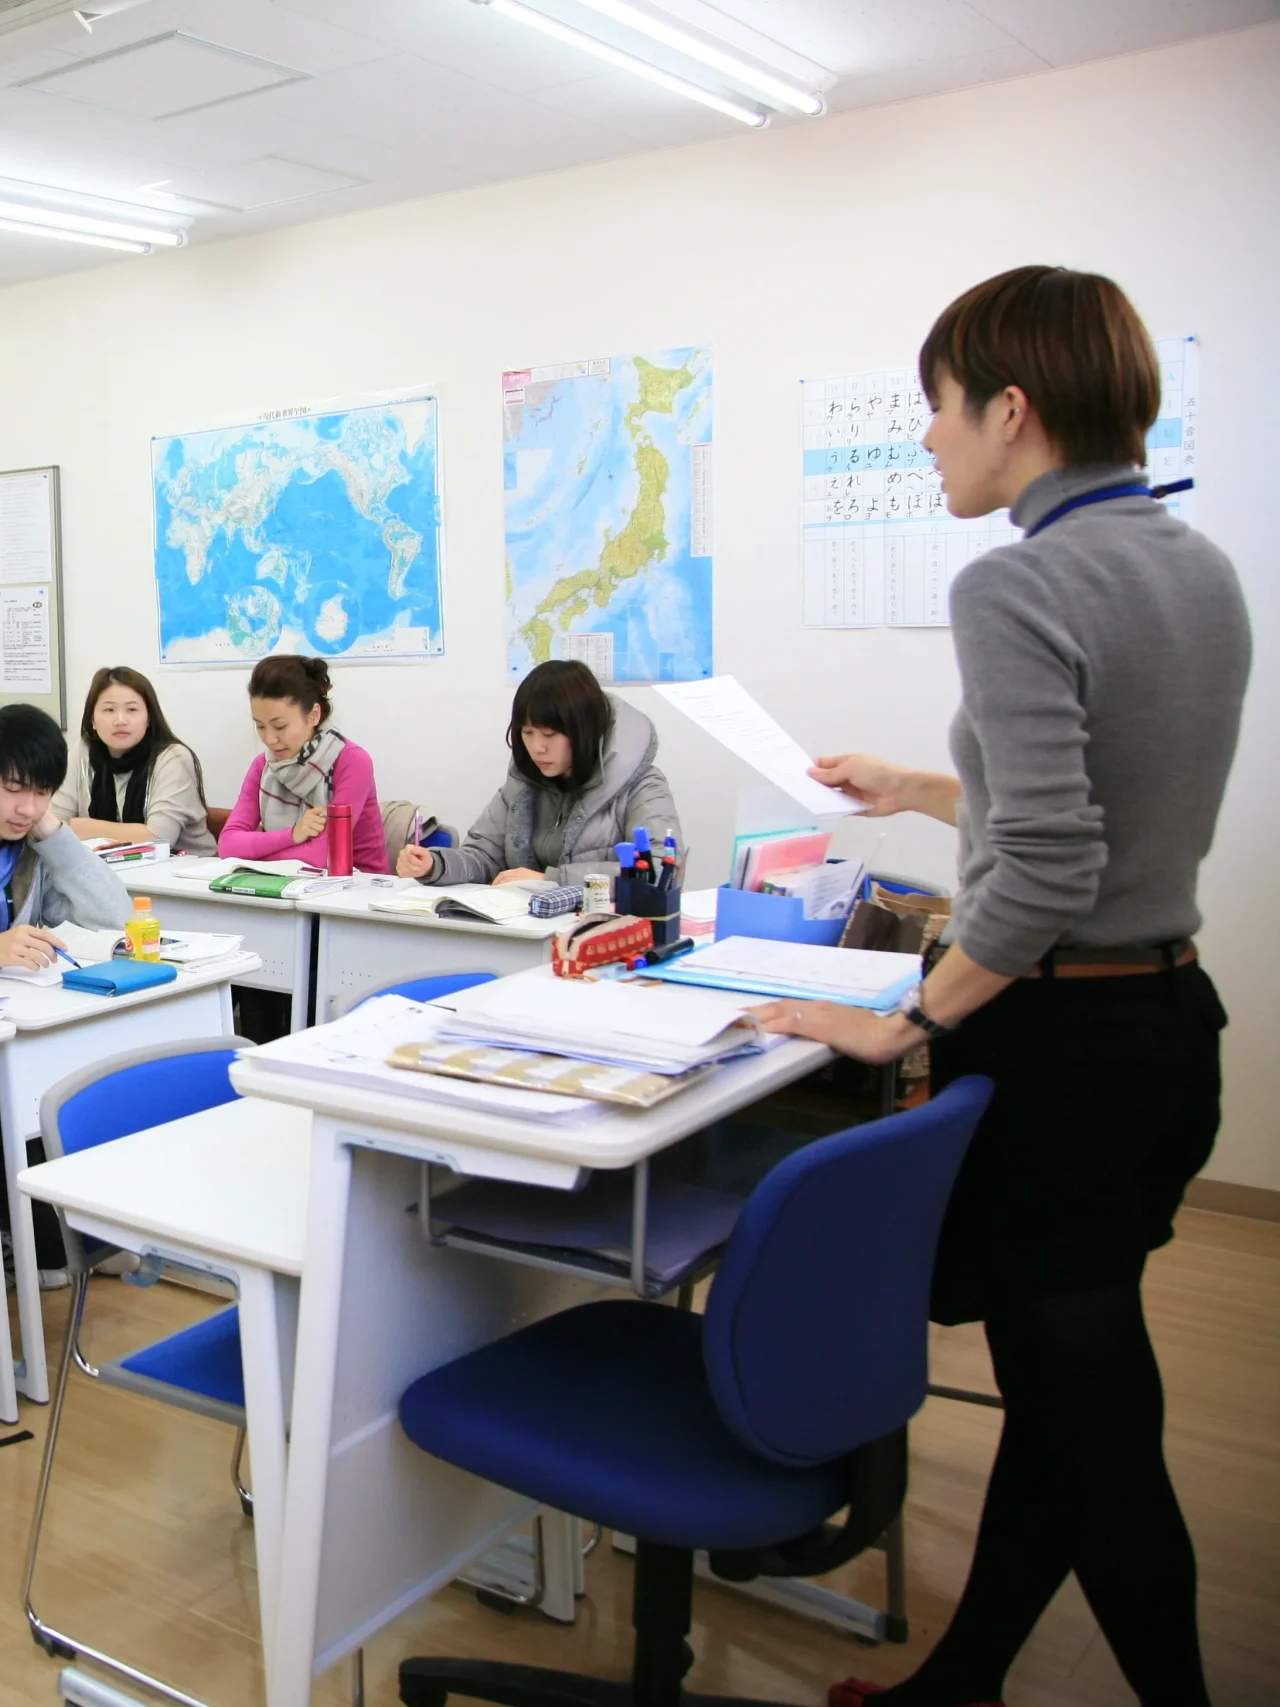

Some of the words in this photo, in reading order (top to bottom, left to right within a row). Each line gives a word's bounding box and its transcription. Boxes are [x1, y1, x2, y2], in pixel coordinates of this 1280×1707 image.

[828, 400, 843, 415] わ
[850, 397, 861, 413] ら
[868, 395, 883, 410] や
[889, 392, 901, 409] ま
[850, 423, 859, 438] り
[887, 419, 903, 435] み
[849, 449, 860, 464] る
[867, 446, 881, 460] ゆ
[887, 445, 902, 460] む
[846, 474, 862, 489] れ
[887, 472, 902, 484] め
[847, 498, 859, 514] ろ
[866, 497, 879, 512] よ
[889, 495, 900, 511] も
